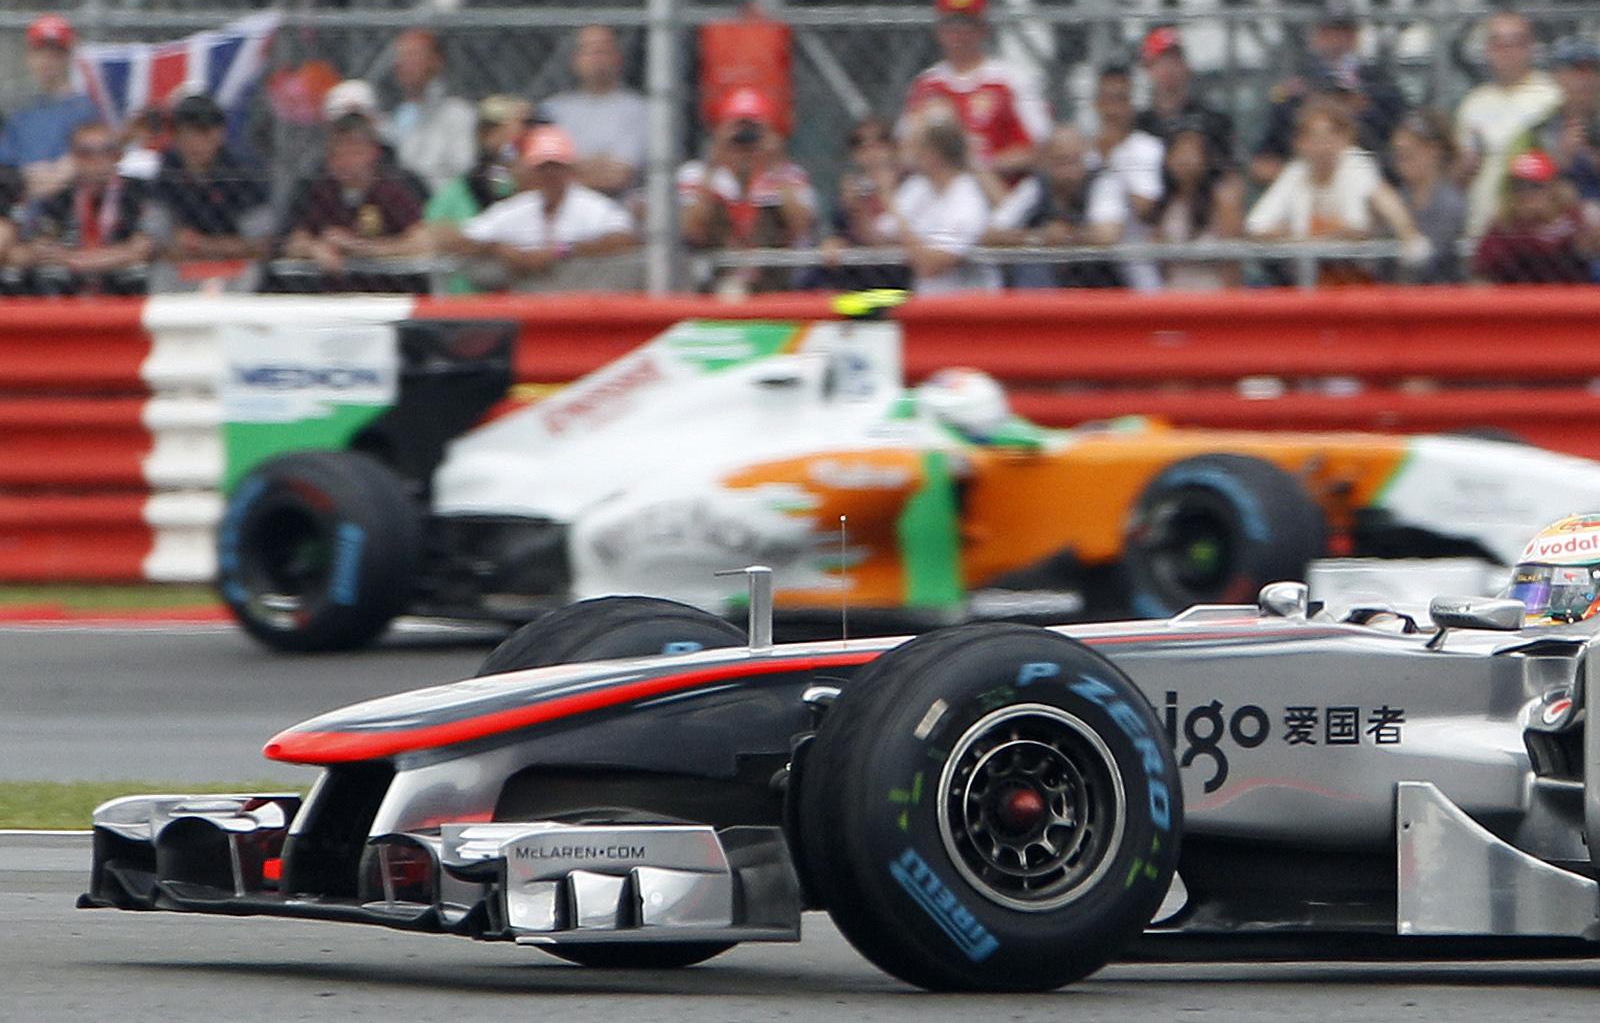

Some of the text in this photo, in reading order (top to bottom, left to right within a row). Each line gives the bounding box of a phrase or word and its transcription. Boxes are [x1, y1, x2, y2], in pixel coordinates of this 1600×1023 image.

[1156, 681, 1406, 793] igo 爱国者
